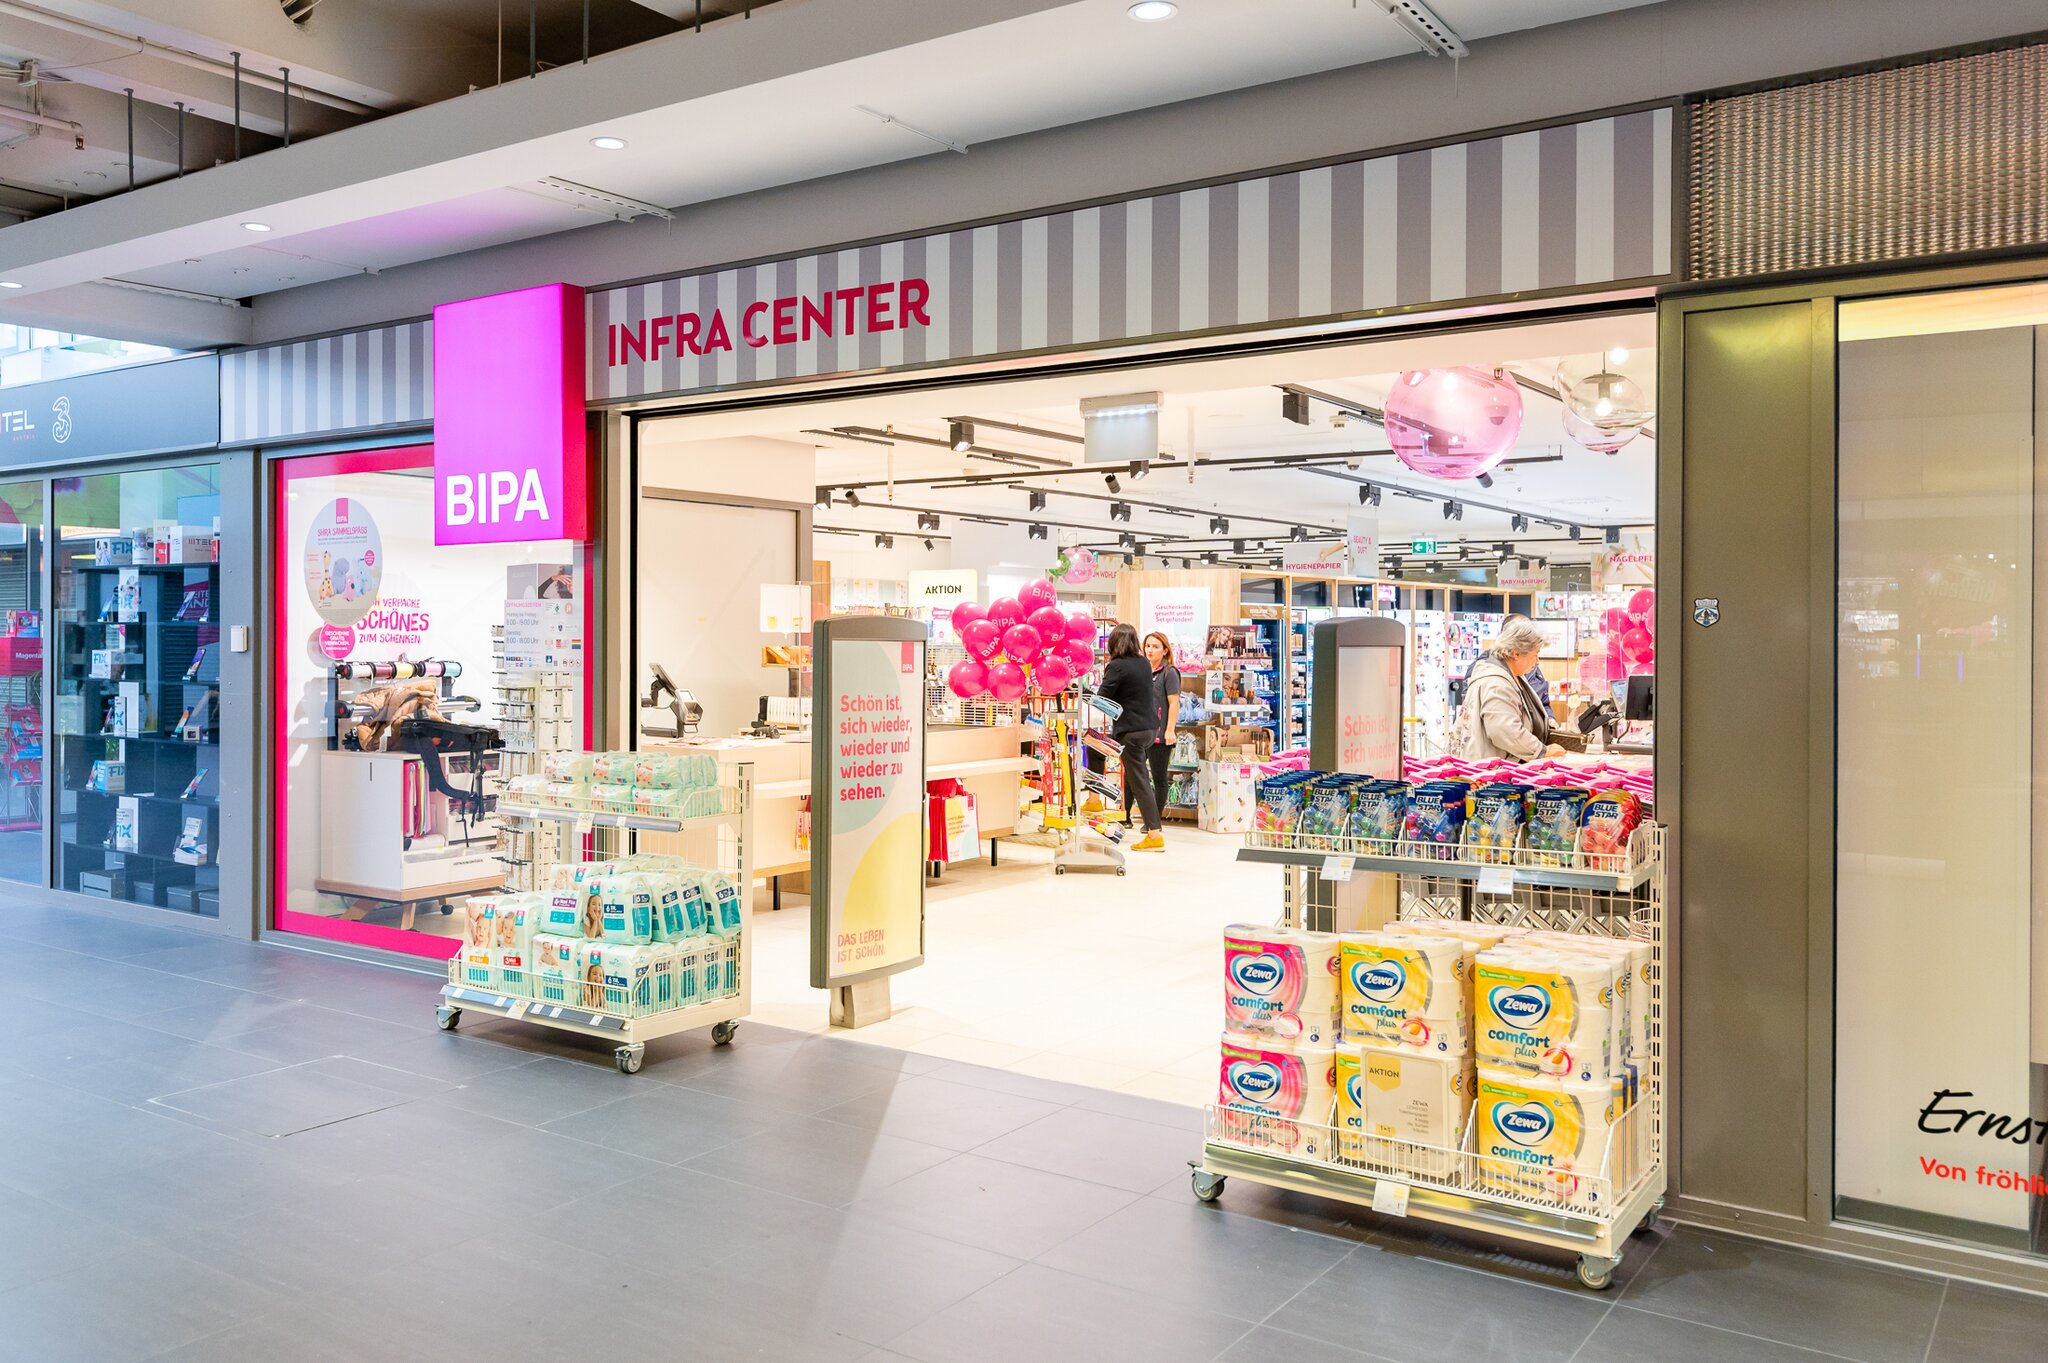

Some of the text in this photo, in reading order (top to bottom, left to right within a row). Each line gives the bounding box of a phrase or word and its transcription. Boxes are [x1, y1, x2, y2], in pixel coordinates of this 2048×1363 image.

[608, 278, 931, 367] INFRA CENTER
[446, 468, 549, 526] BIPA
[1285, 562, 1341, 570] HYGIENEPAPIER
[1500, 577, 1547, 586] BABYNAHRUNG
[925, 584, 962, 595] AKTION
[1032, 586, 1056, 604] BIPA
[383, 597, 421, 608] VERPACKE
[357, 608, 430, 632] SCHÖNES
[359, 634, 377, 644] ZUM
[981, 636, 1001, 657] BIPA
[902, 663, 914, 671] BIPA
[840, 694, 902, 712] Schön ist,
[840, 715, 913, 735] sich wieder,
[1344, 715, 1377, 737] Schön
[840, 737, 910, 757] wieder und
[1343, 741, 1366, 764] sich
[840, 759, 903, 778] wieder zu
[840, 783, 885, 801] sehen.
[1264, 787, 1286, 796] BLUE
[1314, 788, 1337, 796] BLUE
[1360, 793, 1383, 801] BLUE
[1416, 796, 1442, 805] BLUE
[1417, 803, 1441, 811] STAR
[1538, 801, 1563, 809] BLUE
[1593, 803, 1618, 812] BLUE
[1594, 811, 1619, 819] STAR
[837, 929, 884, 948] DAS LEBEN
[837, 948, 853, 963] IST
[1244, 966, 1274, 981] Zewa
[1364, 972, 1394, 987] Zewa
[1231, 995, 1284, 1012] comfort
[1503, 997, 1539, 1014] Zewa
[1351, 1004, 1407, 1019] comfort
[1488, 1029, 1550, 1048] comfort
[1369, 1067, 1400, 1078] AKTION
[1241, 1074, 1271, 1088] Zewa
[1412, 1099, 1429, 1107] ZEWA
[1507, 1113, 1542, 1130] Zewa
[1491, 1145, 1554, 1166] comfort
[1920, 1156, 1966, 1182] Von
